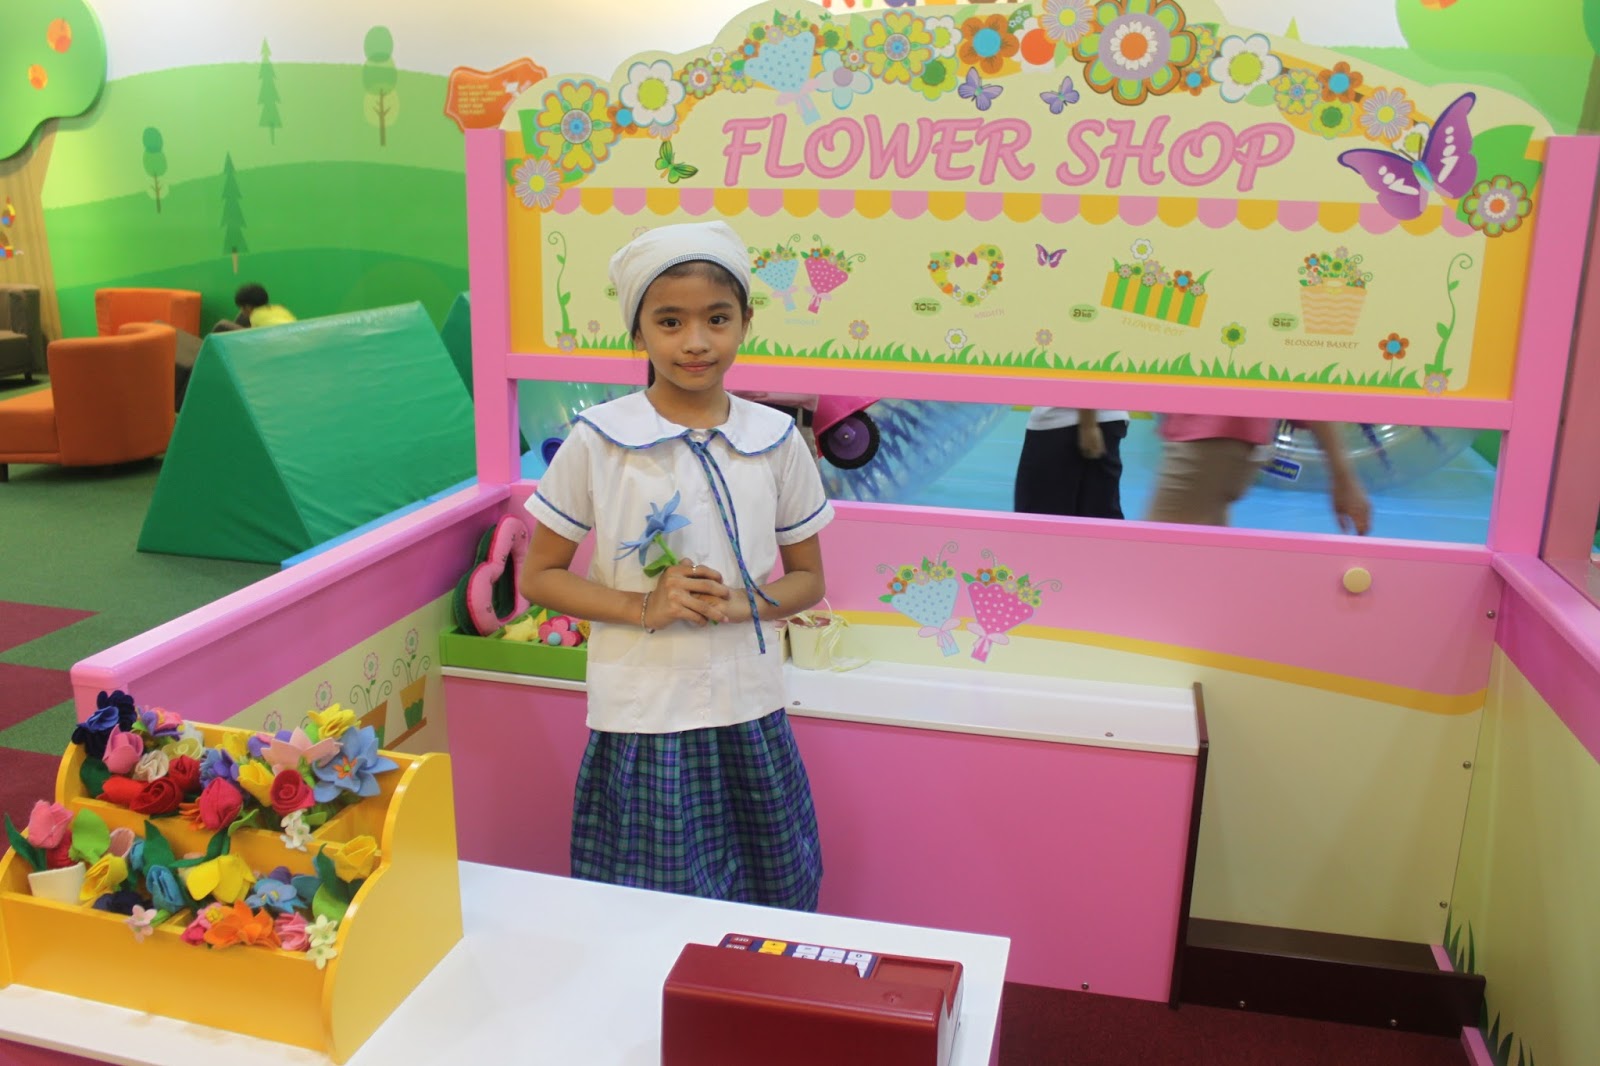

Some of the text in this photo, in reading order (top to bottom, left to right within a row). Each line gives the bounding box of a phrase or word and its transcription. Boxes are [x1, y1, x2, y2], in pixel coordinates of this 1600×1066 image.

[722, 114, 1296, 192] FLOWER SHOP
[914, 302, 927, 311] 10
[1272, 317, 1280, 327] 8
[1284, 338, 1360, 350] BLOSSOM BASKET
